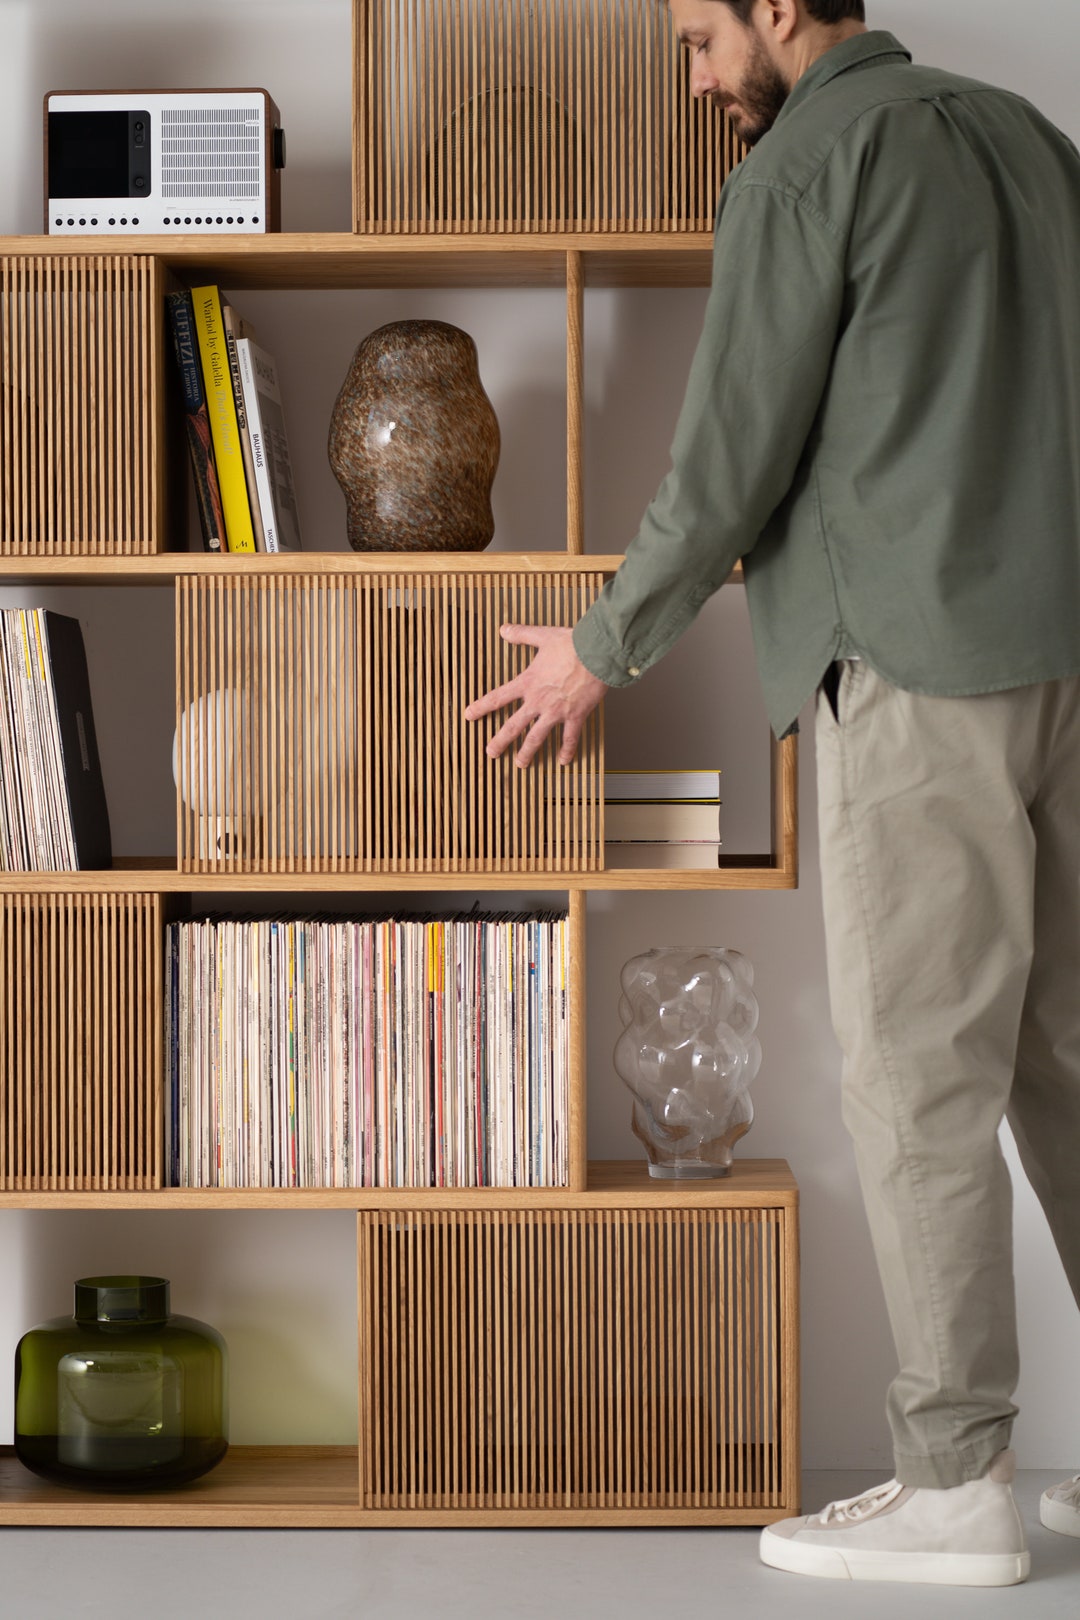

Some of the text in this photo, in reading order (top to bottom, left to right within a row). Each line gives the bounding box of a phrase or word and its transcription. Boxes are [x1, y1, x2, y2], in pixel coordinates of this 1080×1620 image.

[203, 298, 216, 335] Warhol
[175, 308, 193, 365] UFFIZI
[206, 336, 218, 350] by
[190, 367, 200, 402] HISTORIA
[210, 352, 223, 387] Galella
[252, 433, 263, 467] BAUHAUS
